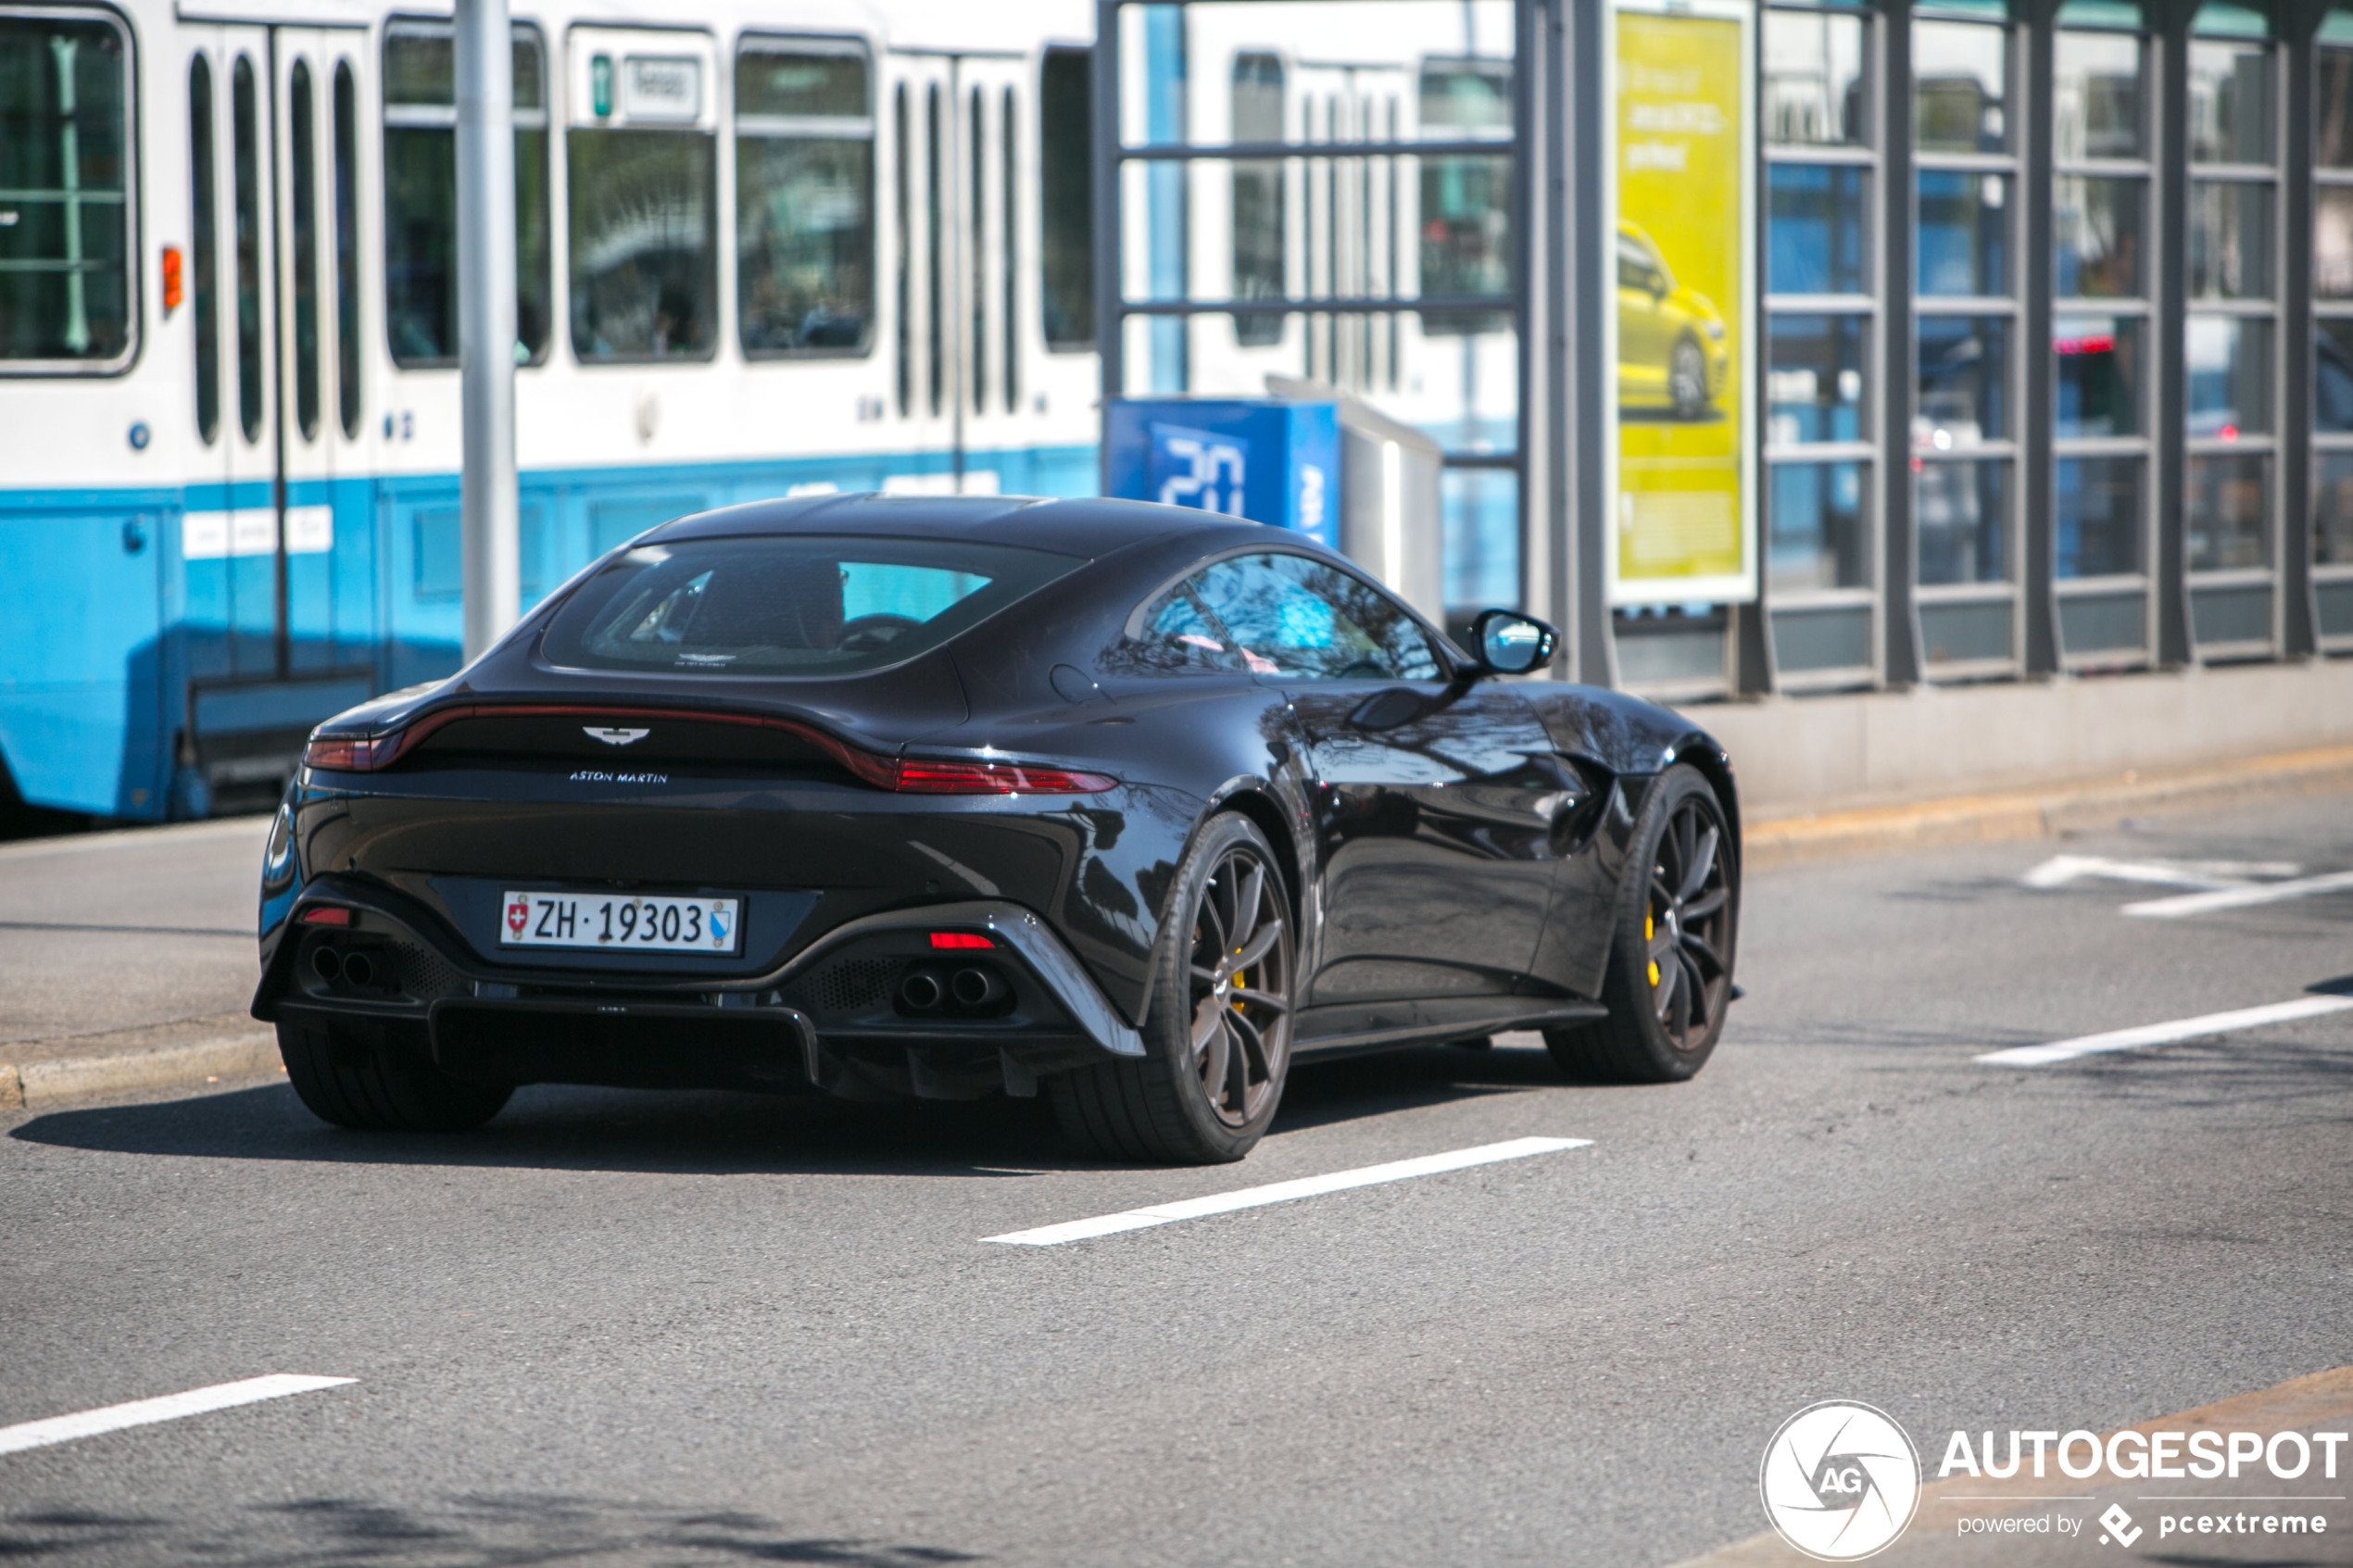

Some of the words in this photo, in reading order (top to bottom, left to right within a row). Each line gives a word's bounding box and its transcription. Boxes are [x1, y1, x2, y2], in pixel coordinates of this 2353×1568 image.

[1161, 438, 1244, 518] 20
[570, 771, 613, 783] ASTON
[617, 772, 668, 784] MARTIN
